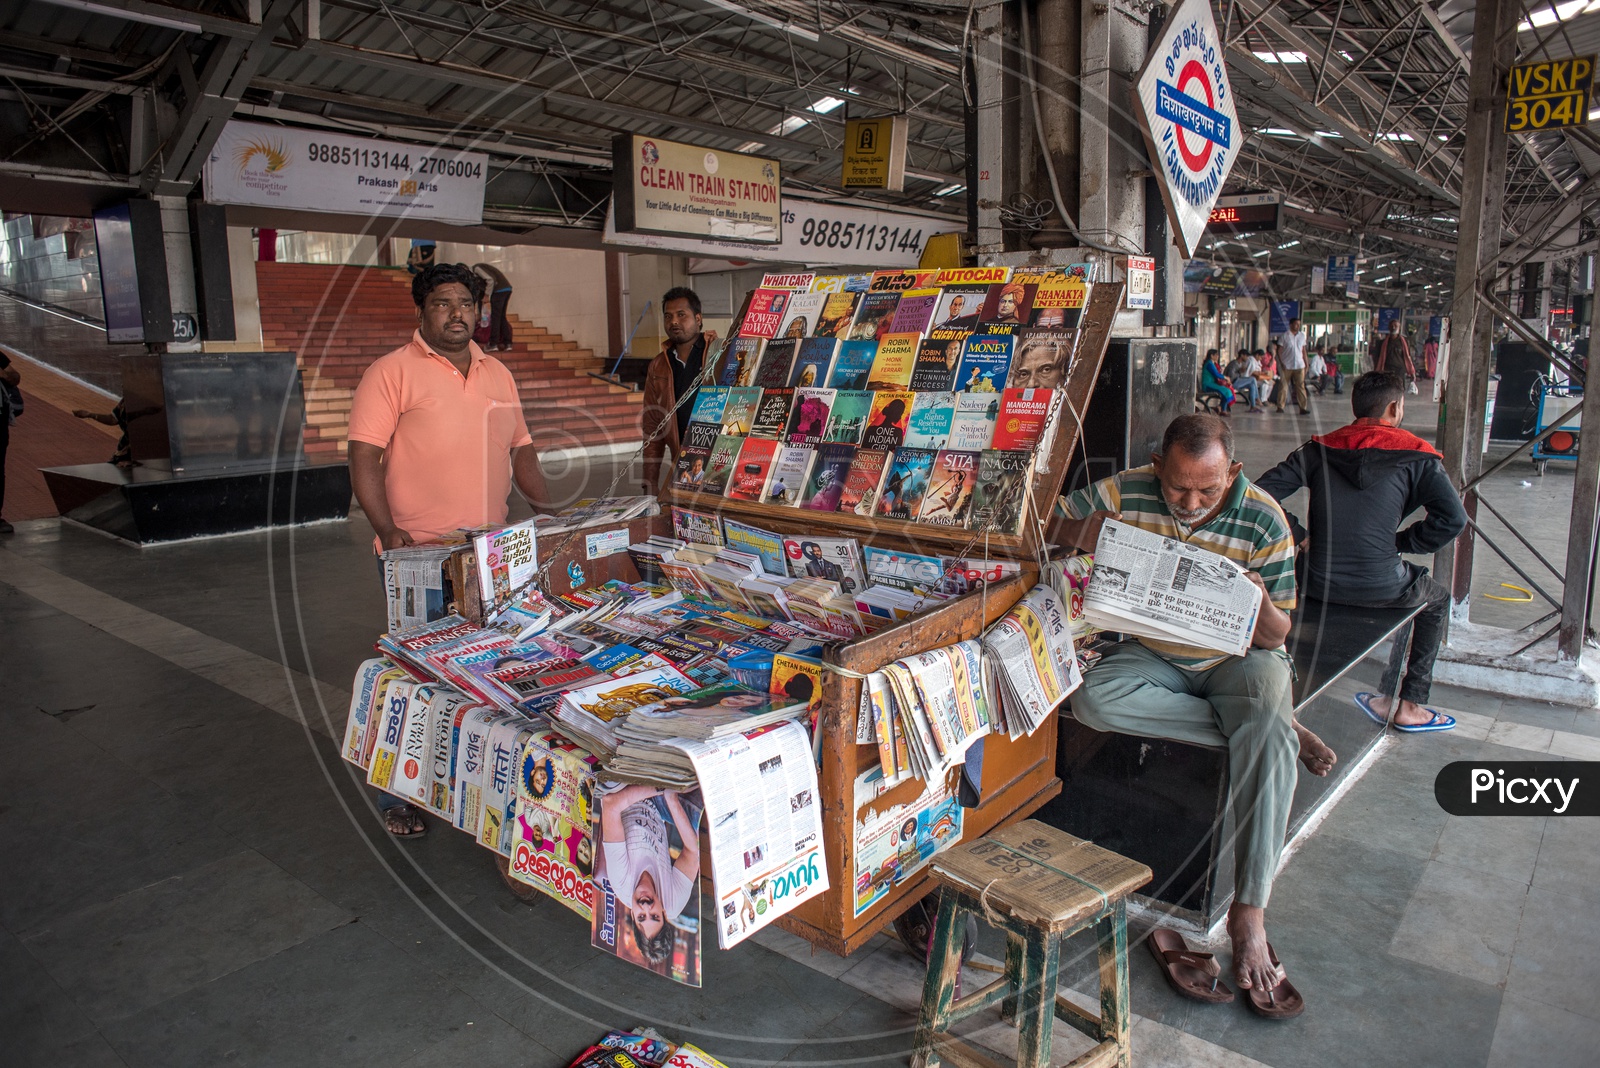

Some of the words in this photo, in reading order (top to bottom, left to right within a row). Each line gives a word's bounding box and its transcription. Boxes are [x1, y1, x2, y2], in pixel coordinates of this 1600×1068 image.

[1515, 60, 1591, 96] VSKP
[1509, 94, 1584, 130] 3041
[308, 142, 414, 175] 9885113144,
[419, 156, 481, 179] 2706004
[1163, 125, 1219, 206] VISAKHAPATNAM
[867, 176, 883, 184] OFFICE
[980, 170, 990, 180] 22
[245, 181, 288, 191] competitor
[357, 175, 399, 188] Prakash
[418, 181, 438, 193] Arts
[640, 165, 685, 192] CLEAN
[688, 173, 725, 198] TRAIN
[729, 179, 777, 204] STATION
[689, 195, 737, 207] Visakhapatnam
[645, 200, 658, 210] Your
[658, 202, 672, 212] Little
[673, 203, 681, 212] Act
[688, 205, 715, 216] Cleanliness
[716, 208, 725, 217] Can
[725, 209, 738, 219] Make
[751, 212, 773, 223] Difference
[800, 217, 923, 259] 9885113144,
[935, 269, 1005, 282] AUTOCAR
[1036, 289, 1084, 300] CHANAKYA
[792, 299, 819, 308] KALAM
[1038, 299, 1077, 307] NEETI
[900, 305, 923, 315] STOP
[747, 312, 779, 325] POWER
[172, 320, 194, 337] 25A
[744, 322, 754, 331] TO
[753, 322, 776, 335] WIN
[894, 324, 923, 332] LIVING
[988, 325, 1013, 335] SWAMI
[881, 346, 911, 354] SHARMA
[968, 342, 1008, 353] MONEY
[838, 355, 872, 366] COELHO
[914, 373, 951, 381] STUNNING
[912, 381, 945, 389] SUCCESS
[700, 400, 719, 409] Love
[764, 399, 786, 409] Love
[959, 400, 987, 412] Sudeep
[1006, 401, 1047, 410] MANORAMA
[924, 413, 945, 421] Rights
[917, 419, 947, 427] Reserved
[691, 425, 704, 433] YOU
[703, 426, 720, 435] CAN
[876, 427, 895, 435] ONE
[928, 426, 940, 434] You
[959, 425, 987, 434] Swiped
[691, 435, 714, 447] WIN
[868, 435, 898, 445] INDIAN
[979, 433, 990, 442] My
[957, 438, 983, 448] Heart
[751, 445, 767, 453] DAN
[710, 453, 735, 465] BROWN
[742, 452, 773, 462] BROWN
[858, 453, 882, 462] SIDNEY
[895, 456, 930, 465] IKSHVAKU
[943, 454, 974, 468] SITA
[851, 461, 882, 471] SHELDON
[982, 457, 1026, 471] NAGAS
[740, 479, 757, 487] CODE
[850, 475, 868, 485] Rage
[883, 511, 907, 519] AMISH
[930, 518, 956, 526] AMISH
[784, 539, 815, 560] GQ
[835, 545, 848, 556] 30
[869, 574, 889, 585] APACHE
[889, 577, 896, 586] RR
[896, 578, 906, 588] 310
[1164, 594, 1176, 603] की
[1227, 612, 1236, 620] 24
[1230, 622, 1241, 632] ठंड
[406, 625, 479, 651] BUSINESS
[596, 651, 628, 669] General
[776, 658, 799, 670] CHETAN
[799, 664, 822, 677] BHAGAT
[514, 677, 539, 692] MY
[539, 666, 597, 687] MOBILE
[385, 696, 407, 747] వార్త
[406, 711, 420, 756] INDIAN
[413, 705, 429, 760] EXPRESS
[493, 741, 511, 794] वार्ता
[510, 747, 519, 785] TIBCON
[794, 832, 816, 846] Overview
[795, 843, 806, 852] NEWS
